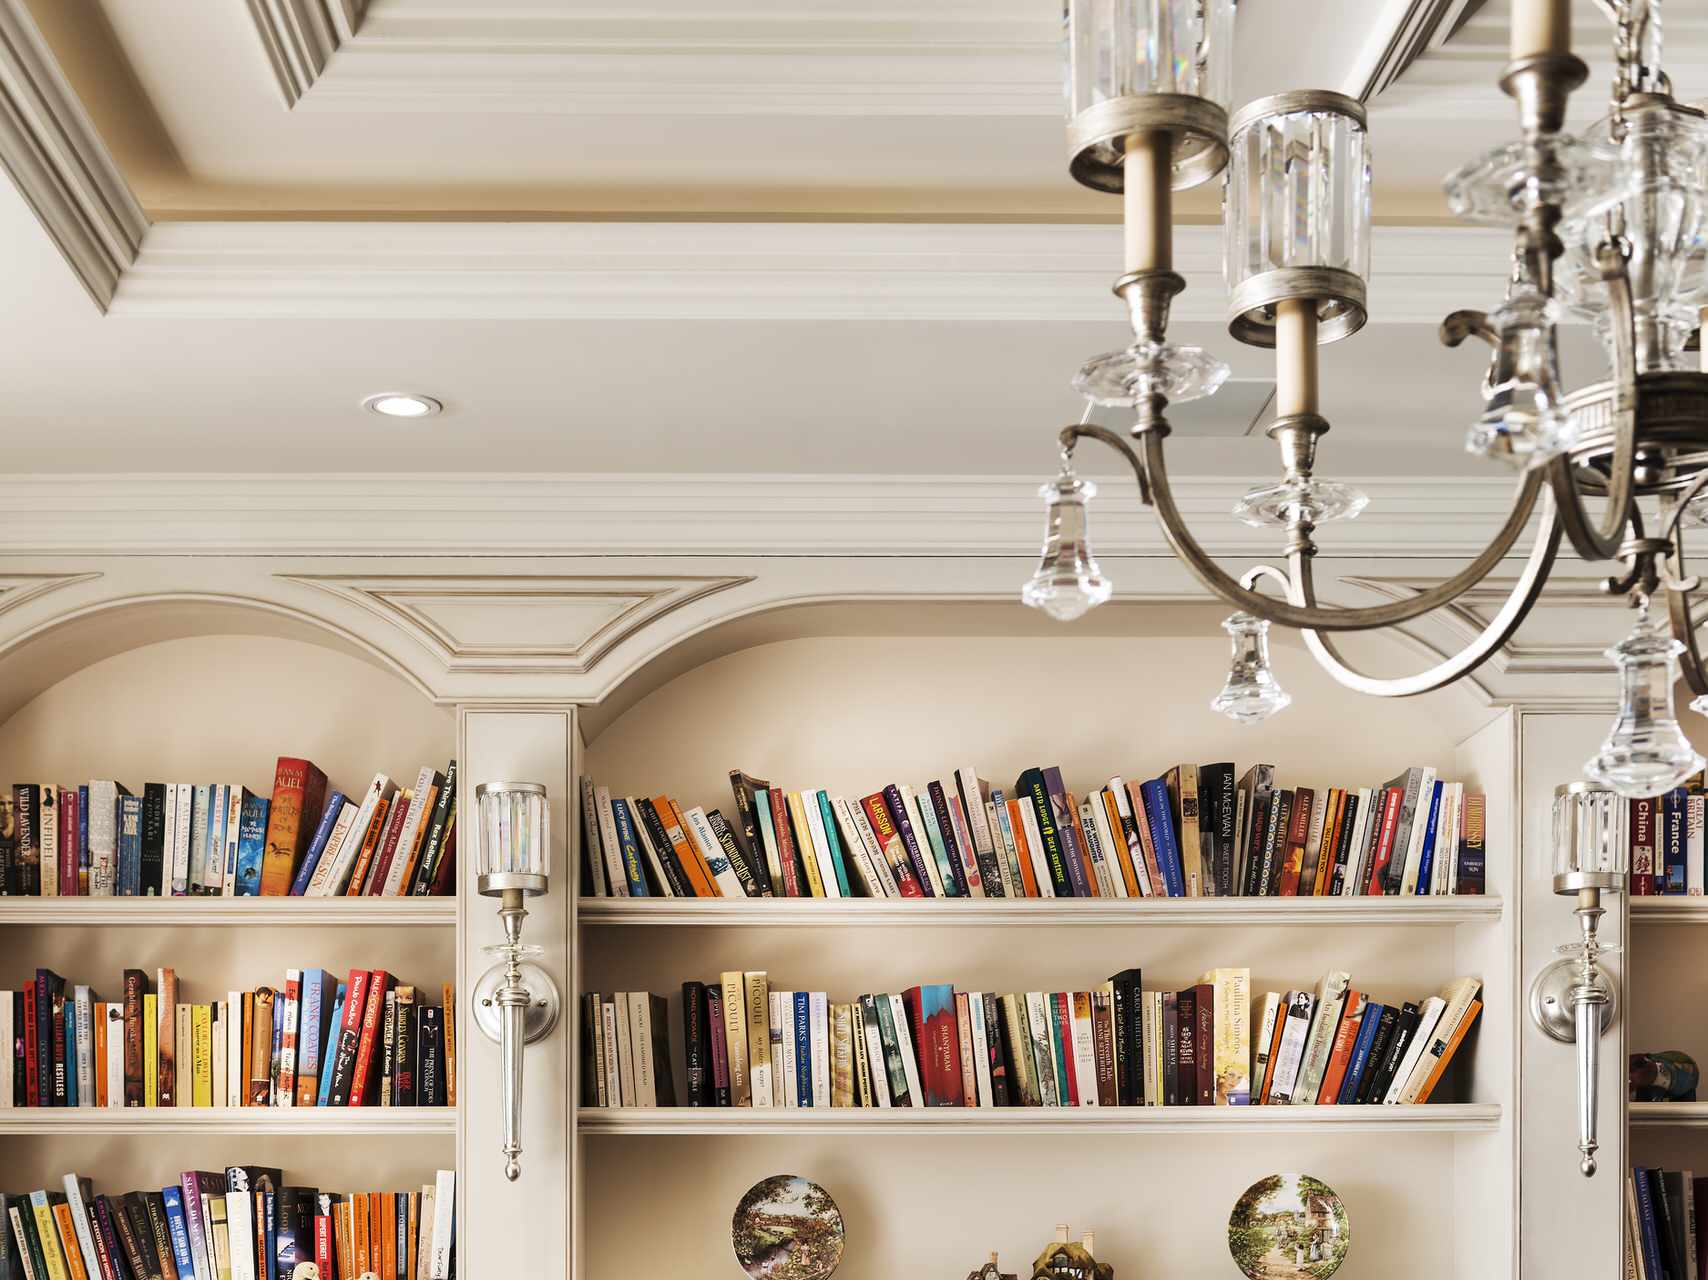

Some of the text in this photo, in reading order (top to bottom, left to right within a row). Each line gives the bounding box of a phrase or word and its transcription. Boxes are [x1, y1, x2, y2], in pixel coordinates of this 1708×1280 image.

[1223, 774, 1232, 789] IAN
[20, 788, 29, 811] WILD
[617, 803, 625, 820] LUCY
[869, 797, 893, 836] LARSSON
[933, 785, 945, 814] DONNA
[1035, 783, 1045, 804] DAVID
[1040, 806, 1049, 826] LODGE
[1696, 798, 1704, 829] GREAT
[20, 813, 31, 856] LAVENDER
[423, 766, 456, 869] Love Thirty Rex Bellamy
[1276, 802, 1288, 848] ALEX MILLER
[1298, 813, 1306, 839] MILLER
[1466, 806, 1482, 850] MORRISSEY
[1638, 802, 1648, 842] China
[1671, 812, 1681, 854] France
[43, 814, 53, 859] INFIDEL
[1082, 818, 1099, 864] MY DAUGHTER
[1088, 817, 1104, 862] NOT WITHOUT
[736, 867, 752, 882] LIST
[911, 842, 926, 877] FORBIDDEN
[1064, 829, 1082, 886] UNDER INFLUENCE
[312, 865, 328, 890] SUN
[128, 977, 137, 1013] Geraldine
[347, 975, 362, 1026] Paulo Coelho
[365, 975, 381, 1028] PAULO COELHO
[752, 978, 762, 1026] PICOULT
[855, 1007, 860, 1015] MY
[1325, 1002, 1333, 1011] An
[307, 982, 320, 1070] FRANK COATES
[399, 1008, 409, 1033] SHIRLEY
[1231, 976, 1244, 1056] Paullina Simons
[941, 1024, 951, 1072] SHANTARAM
[56, 1063, 64, 1097] RESTLESS
[1387, 1063, 1396, 1072] ryan
[173, 1215, 182, 1230] HOUSE
[185, 1176, 201, 1248] SUSAN DUNCAN
[281, 1205, 291, 1233] Loop
[319, 1217, 327, 1237] RUPERT
[92, 1220, 105, 1253] EXECUTION
[177, 1236, 185, 1248] SAND
[179, 1248, 187, 1257] AND
[181, 1257, 189, 1265] FOG
